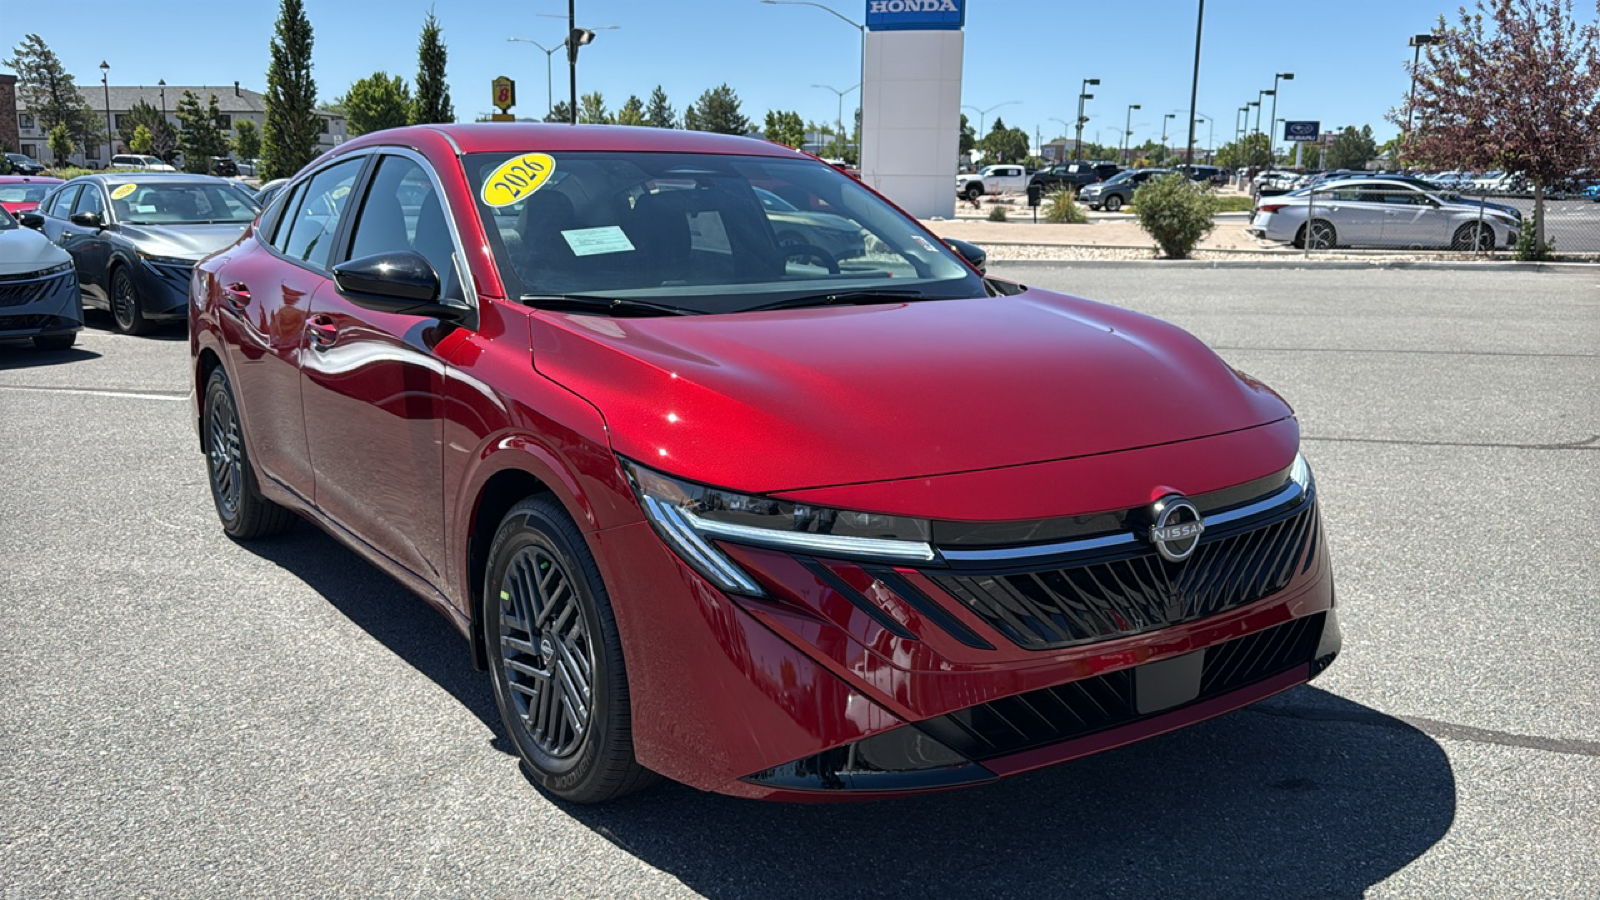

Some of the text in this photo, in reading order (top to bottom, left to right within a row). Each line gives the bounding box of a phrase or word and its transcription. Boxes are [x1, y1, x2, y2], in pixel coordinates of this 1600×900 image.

[869, 0, 958, 13] HONDA
[499, 87, 510, 102] 8
[494, 158, 545, 198] 2026
[1154, 523, 1205, 540] NISSAN
